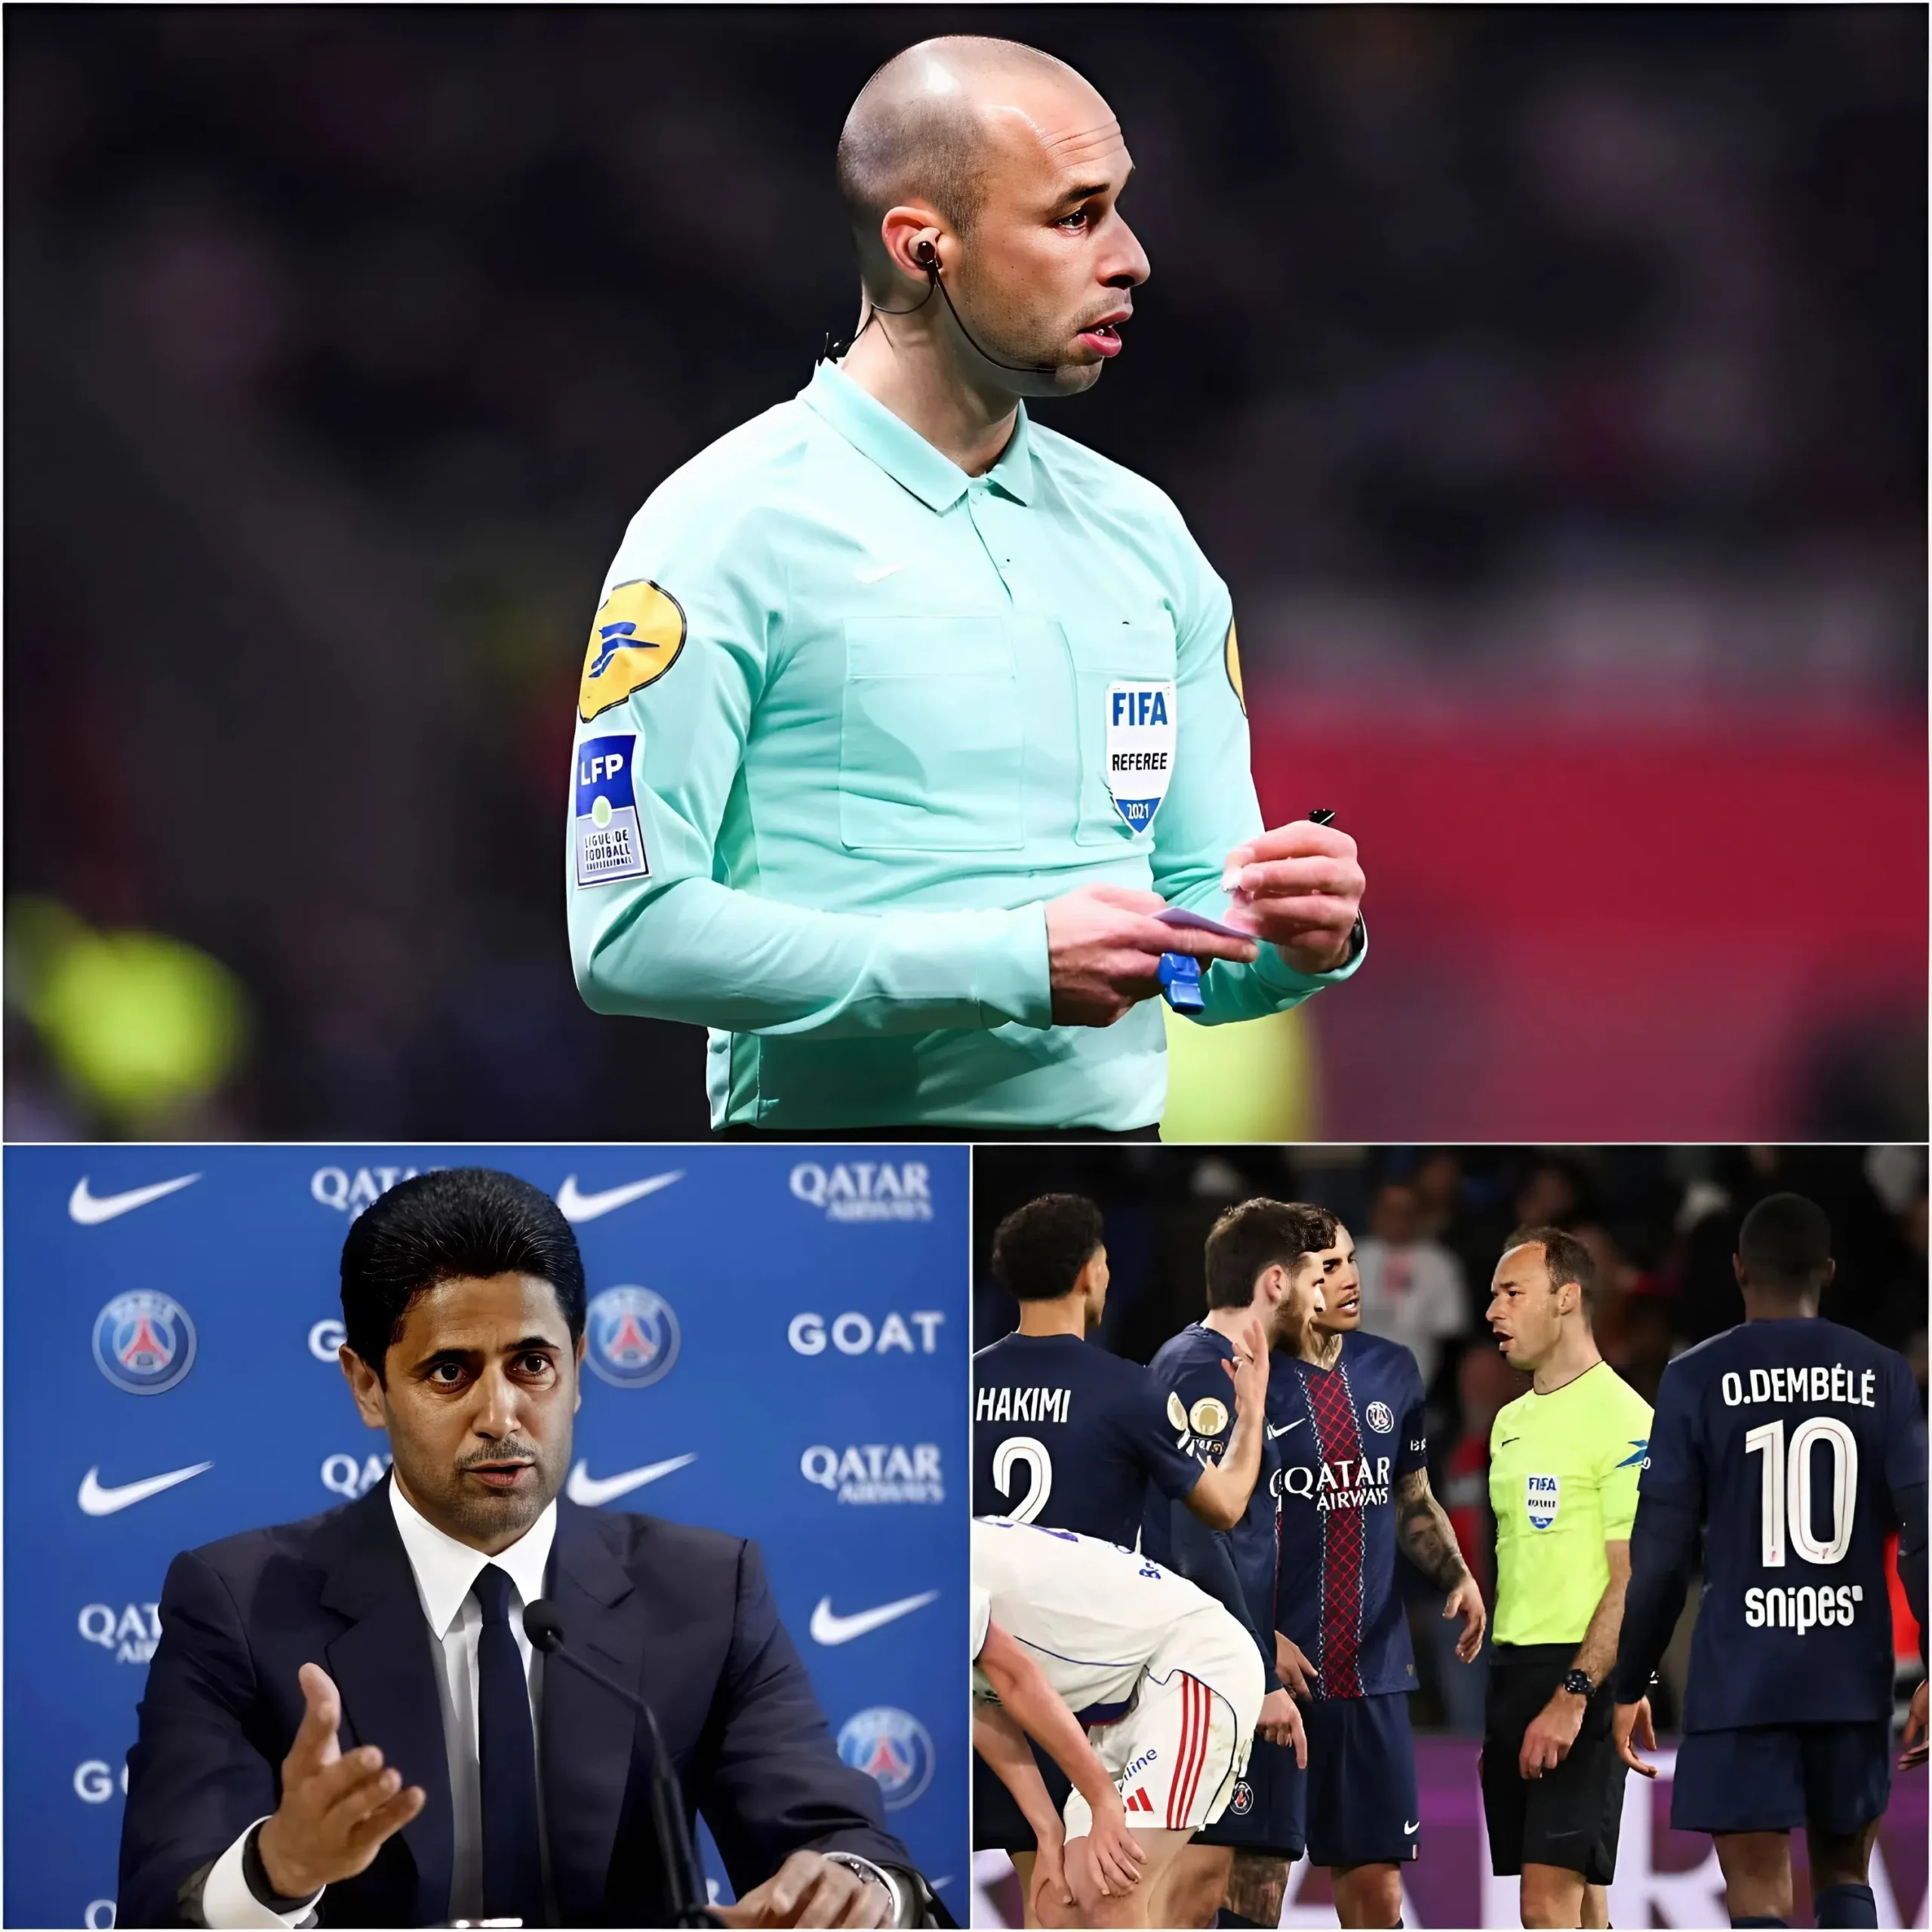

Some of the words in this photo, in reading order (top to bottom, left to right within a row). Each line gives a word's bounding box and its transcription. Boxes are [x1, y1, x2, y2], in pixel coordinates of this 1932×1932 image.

[1112, 692, 1168, 726] FIFA
[580, 753, 623, 786] LFP
[1112, 752, 1168, 771] REFEREE
[1127, 803, 1149, 820] 2021
[311, 1166, 447, 1211] QAT
[789, 1162, 931, 1208] QATAR
[788, 1312, 945, 1355] GOAT
[976, 1388, 1072, 1423] HAKIMI
[1721, 1363, 1876, 1407] O.DEMBÉLÉ
[800, 1444, 941, 1491] QATAR
[992, 1436, 1052, 1524] 2
[1284, 1457, 1389, 1500] QATAR
[1529, 1478, 1556, 1491] FIFA
[1746, 1417, 1858, 1567] 10
[78, 1602, 163, 1650] QAT
